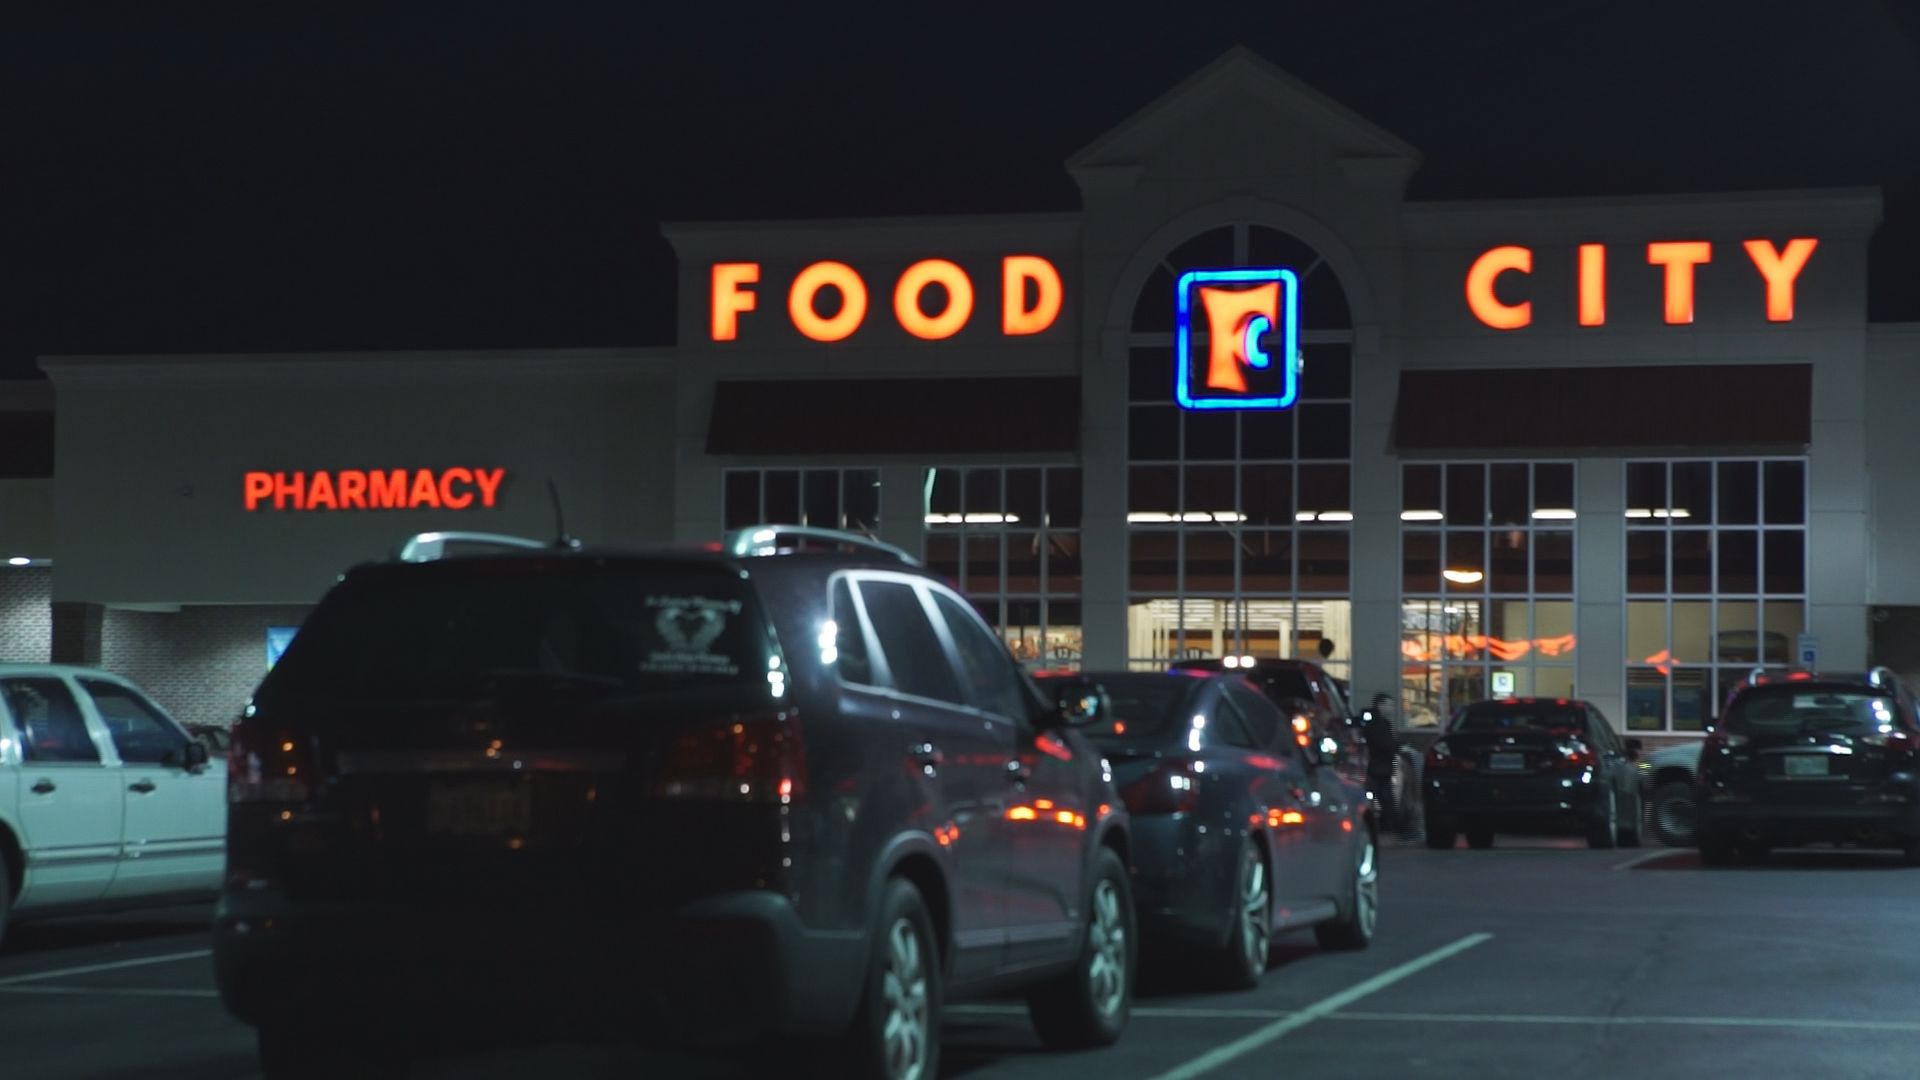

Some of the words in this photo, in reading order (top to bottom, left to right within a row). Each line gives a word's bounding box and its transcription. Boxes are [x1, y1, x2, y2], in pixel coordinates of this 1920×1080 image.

[711, 254, 1065, 342] FOOD
[1464, 237, 1820, 330] CITY
[243, 466, 506, 511] PHARMACY
